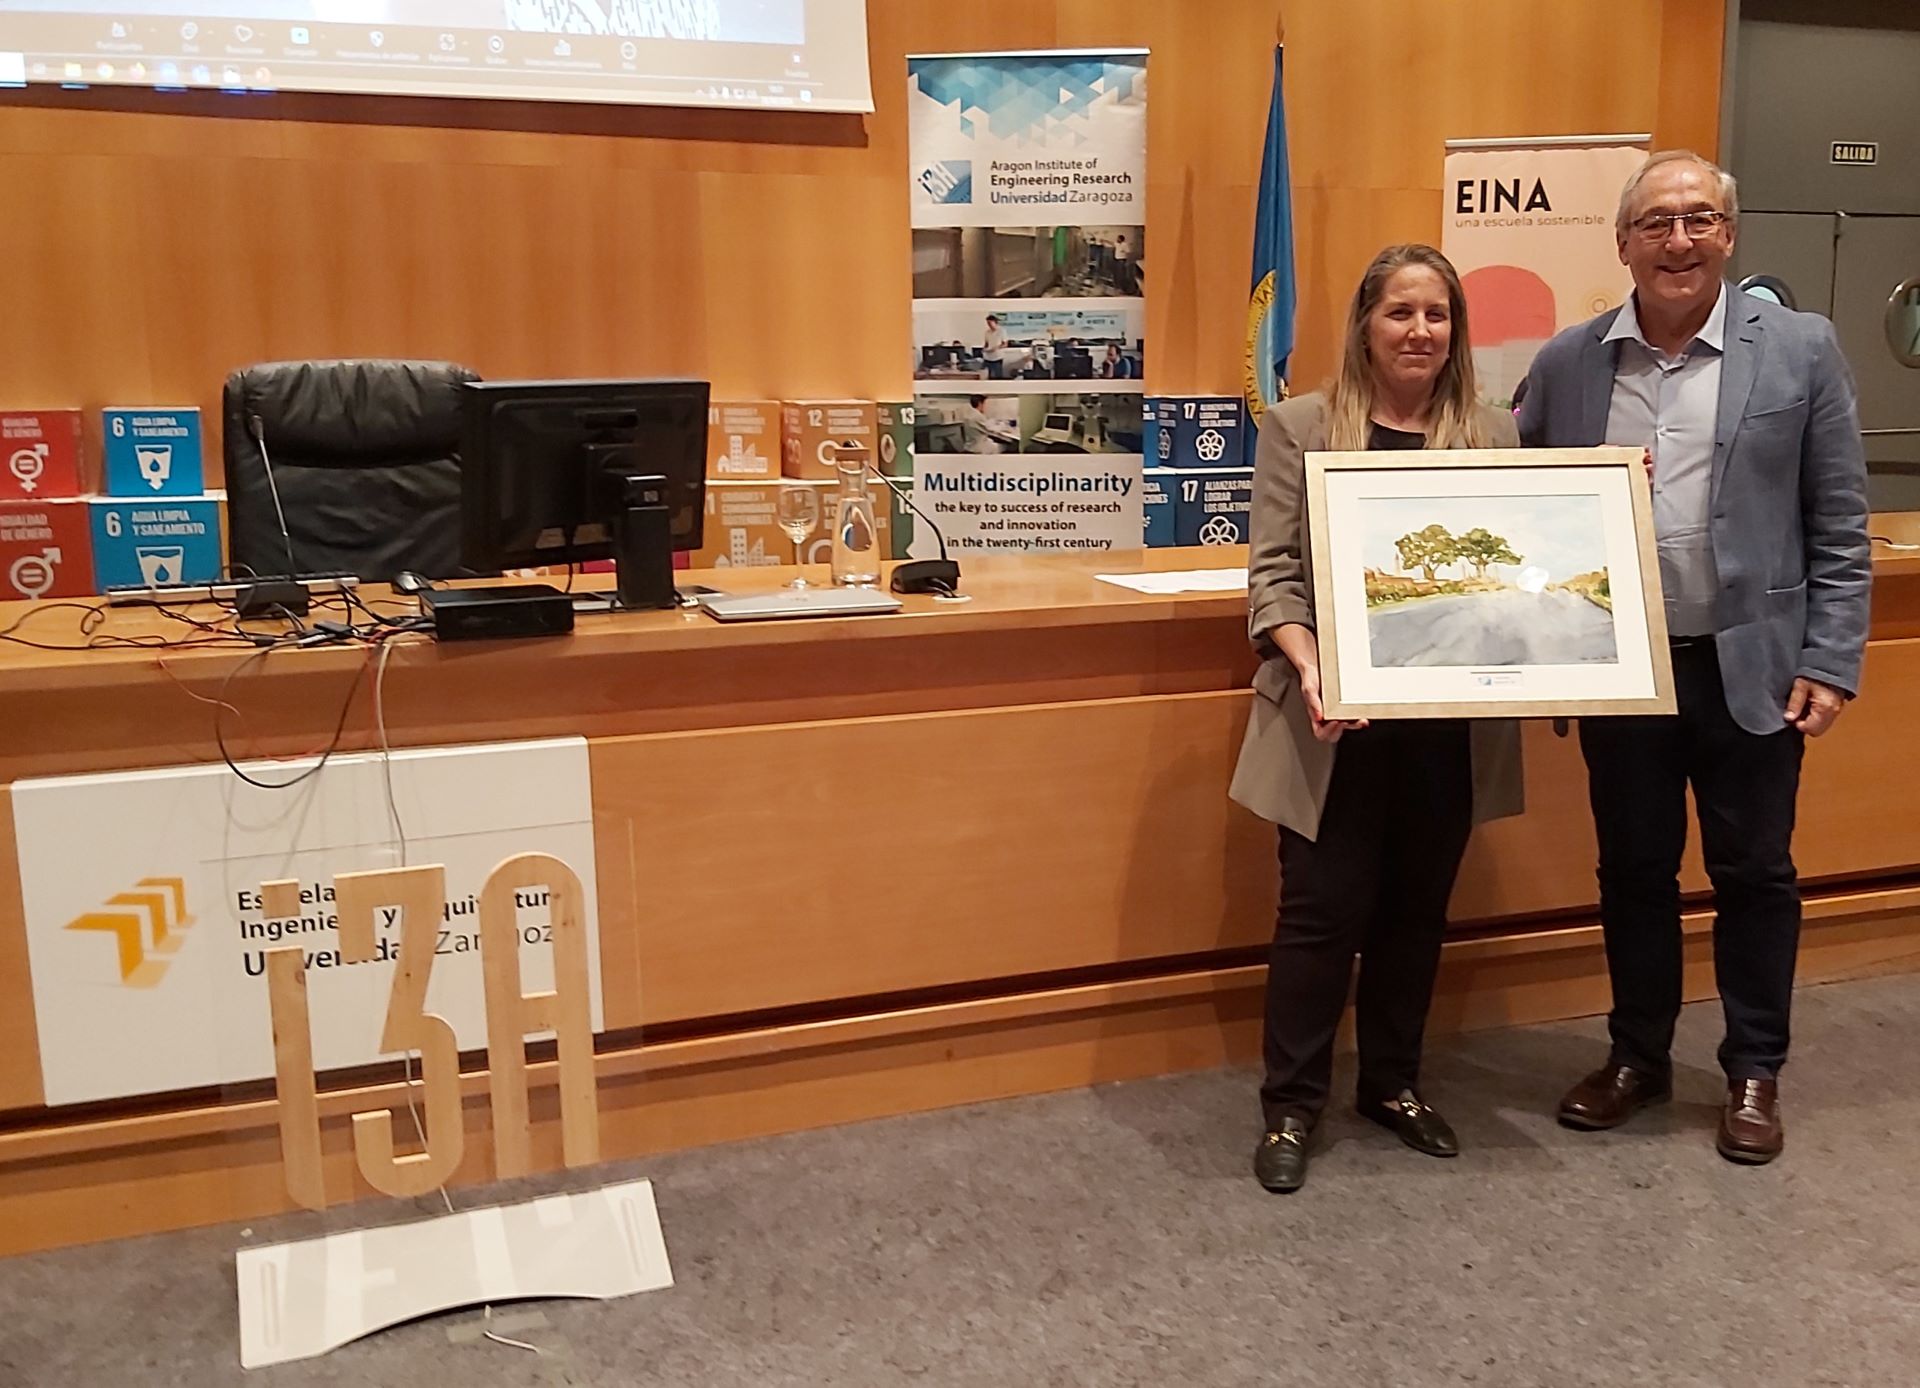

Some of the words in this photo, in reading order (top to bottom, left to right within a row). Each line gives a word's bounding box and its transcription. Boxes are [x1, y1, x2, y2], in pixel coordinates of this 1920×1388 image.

[1834, 146, 1873, 160] SALIDA
[990, 160, 1032, 174] Aragon
[1035, 159, 1082, 170] Institute
[1085, 158, 1098, 169] of
[991, 174, 1069, 189] Engineering
[1073, 172, 1132, 184] Research
[991, 191, 1067, 204] Universidad
[1069, 190, 1133, 206] Zaragoza
[1456, 177, 1552, 214] EINA
[1455, 218, 1480, 228] una
[1484, 216, 1533, 227] escuela
[1537, 214, 1606, 227] sostenible
[808, 409, 822, 427] 12
[900, 407, 915, 424] 13
[1183, 403, 1196, 419] 17
[112, 417, 125, 437] 6
[924, 472, 1133, 496] Multidisciplinarity
[1181, 480, 1198, 502] 17
[935, 502, 956, 513] the
[959, 502, 980, 515] key
[985, 503, 998, 513] to
[1000, 504, 1048, 513] success
[1050, 501, 1065, 513] of
[1067, 501, 1122, 513] research
[105, 511, 121, 537] 6
[979, 519, 1003, 530] and
[1007, 519, 1076, 530] innovation
[947, 537, 959, 548] in
[962, 537, 981, 548] the
[986, 537, 1060, 550] twenty-first
[1063, 538, 1112, 550] century
[238, 882, 336, 911] Esela
[382, 908, 396, 929] y
